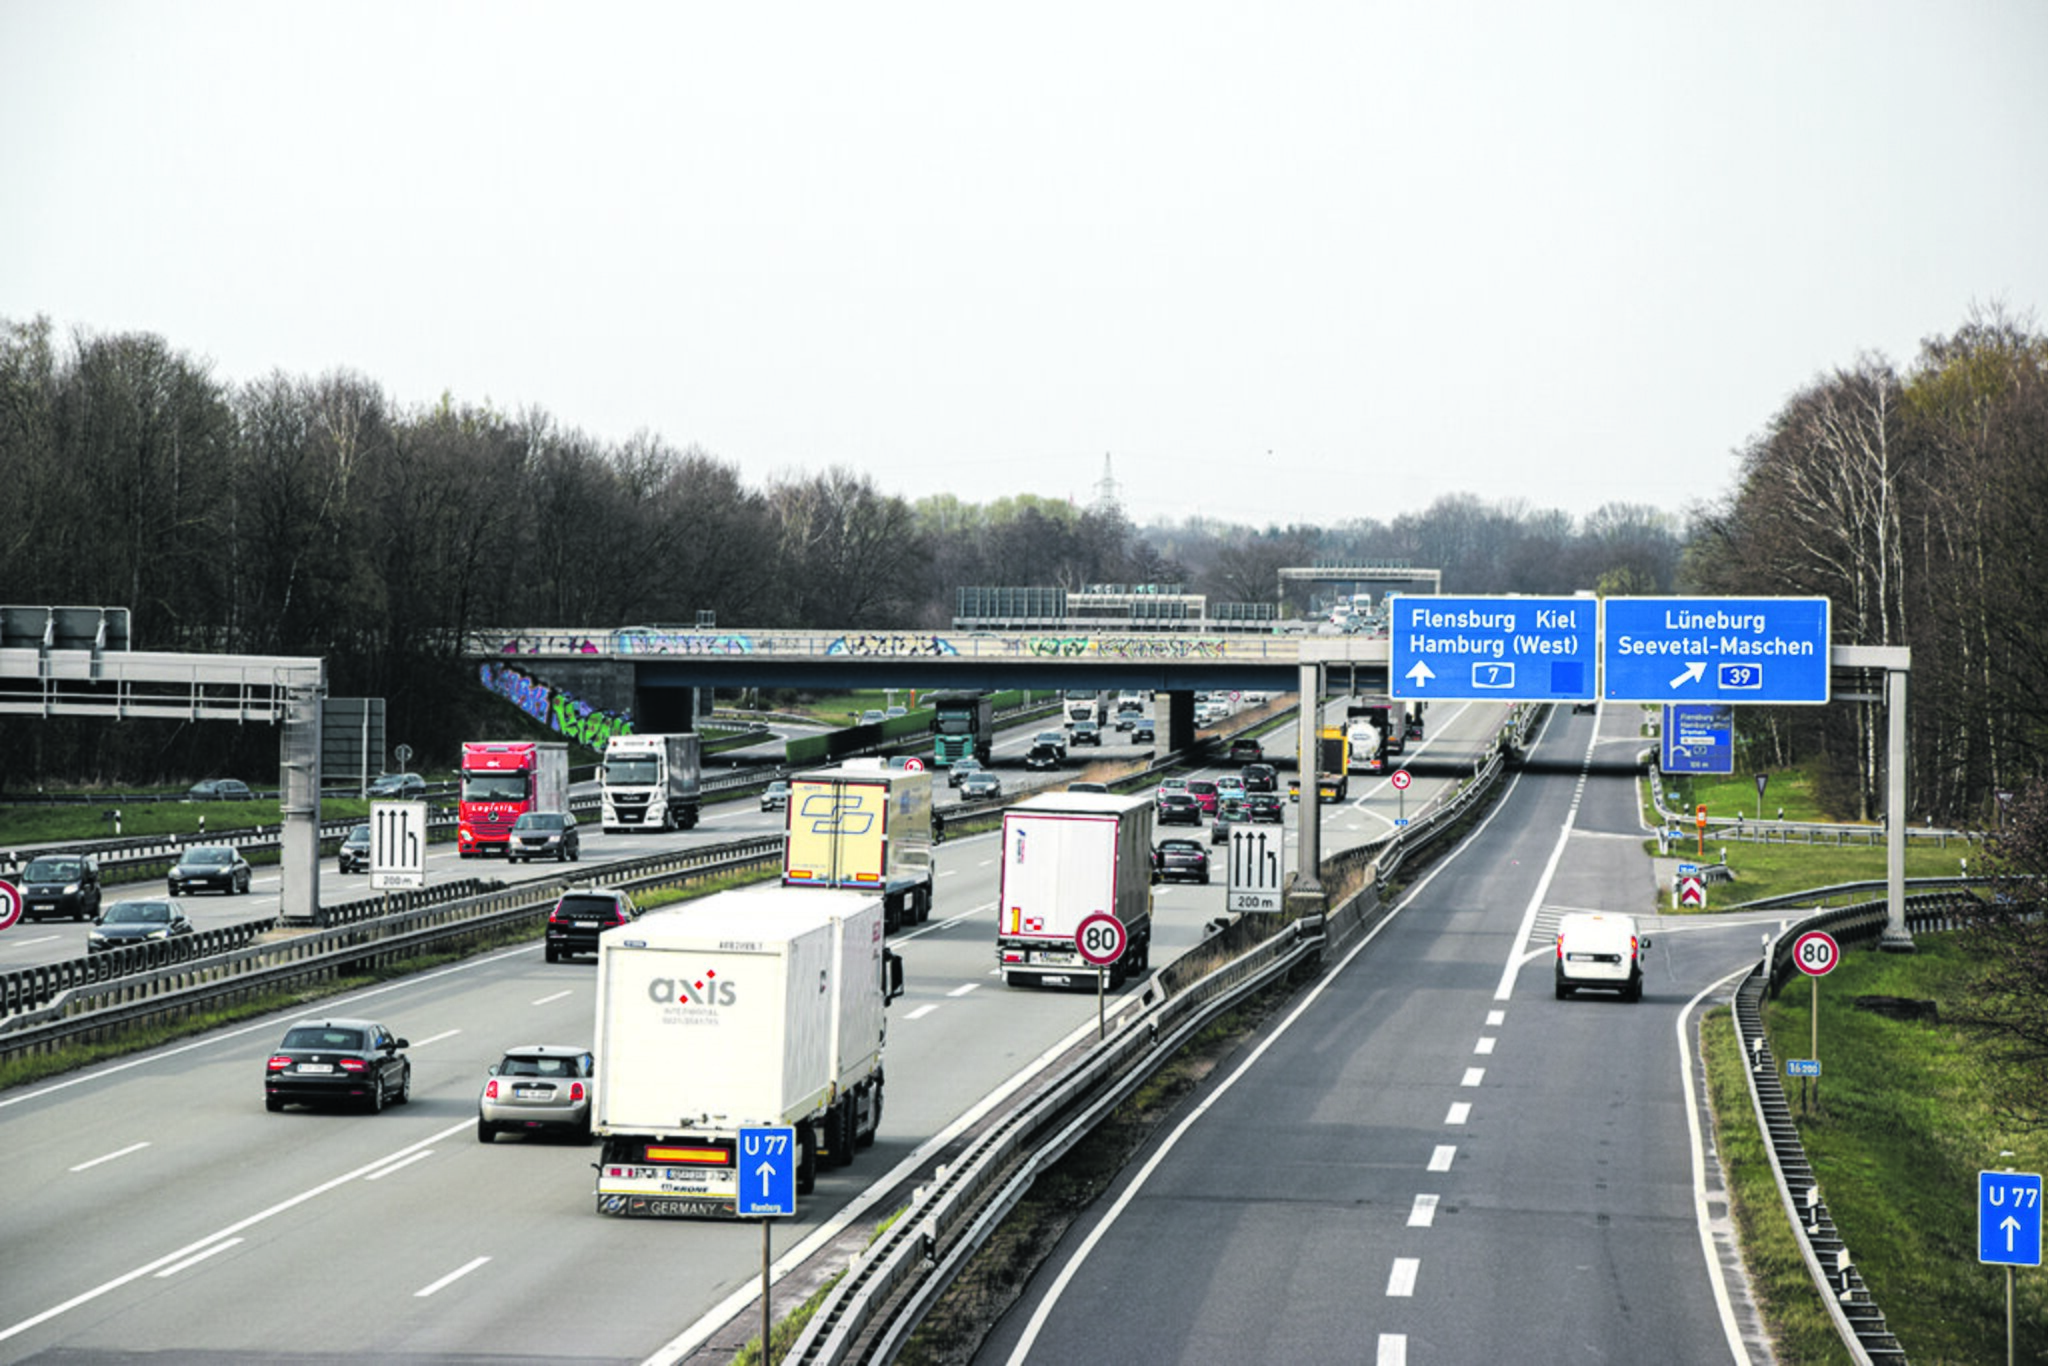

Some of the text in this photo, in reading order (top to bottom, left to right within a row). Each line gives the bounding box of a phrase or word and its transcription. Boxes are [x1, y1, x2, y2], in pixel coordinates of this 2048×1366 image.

[1412, 609, 1576, 632] Flensburg Kiel
[1665, 610, 1766, 633] Lüneburg
[1410, 634, 1578, 658] Hamburg (West)
[1618, 636, 1814, 655] Seevetal-Maschen
[1488, 667, 1499, 683] 7
[1729, 669, 1750, 684] 39
[384, 876, 412, 885] 200 m
[1238, 896, 1273, 908] 200 m
[1086, 927, 1115, 950] 80
[1804, 943, 1829, 963] 80
[648, 969, 737, 1006] axis
[745, 1136, 788, 1155] U 77
[1990, 1185, 2038, 1208] U 77
[651, 1201, 717, 1215] GERMANY
